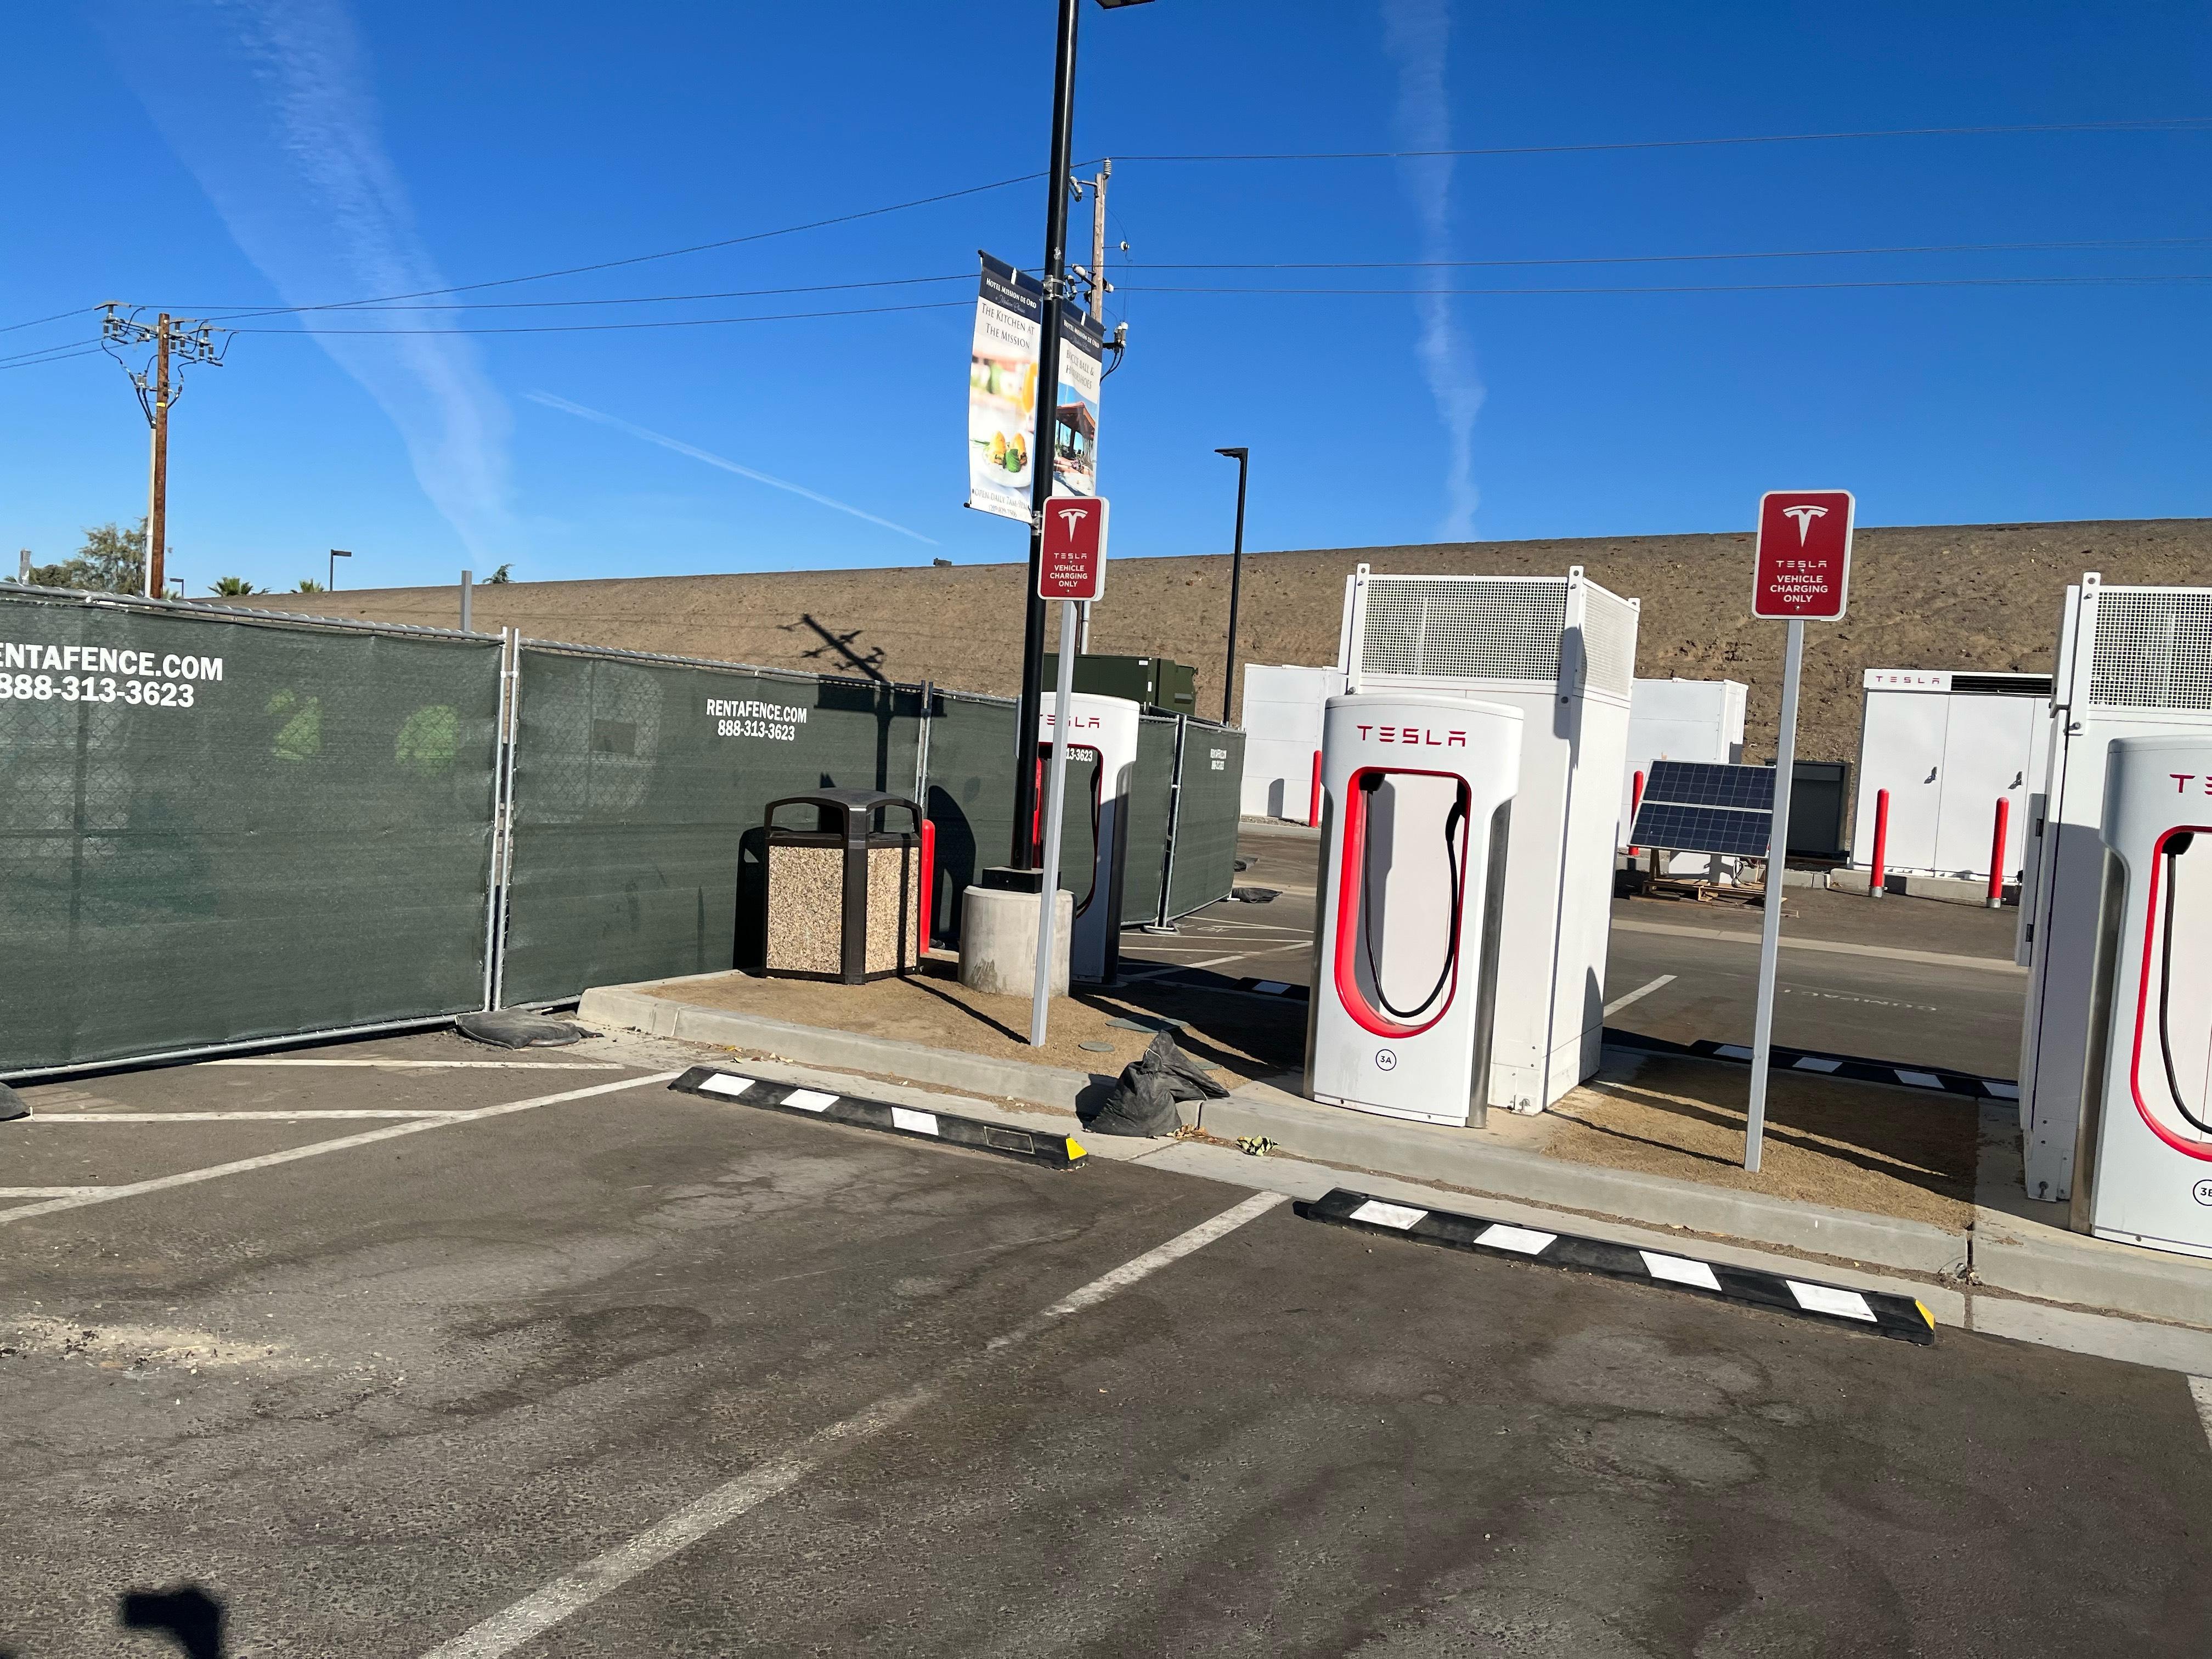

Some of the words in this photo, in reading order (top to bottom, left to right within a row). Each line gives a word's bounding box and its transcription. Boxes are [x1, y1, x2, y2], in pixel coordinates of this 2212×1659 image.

[986, 278, 1001, 291] HOTEL
[1001, 286, 1020, 300] MISSION
[1026, 298, 1037, 308] ORO
[982, 303, 994, 318] THE
[996, 310, 1025, 331] KITCHEN
[1027, 325, 1035, 335] AT
[986, 323, 999, 337] THE
[1001, 330, 1030, 349] MISSION
[975, 489, 989, 499] OPEN
[991, 493, 1006, 503] DAILY
[1770, 585, 1828, 593] CHARGING
[1777, 575, 1823, 583] VEHICLE
[0, 642, 223, 681] NTAFENCE.COM
[0, 673, 194, 708] 888-313-3623
[1876, 676, 1940, 684] TESLA
[707, 698, 808, 723] RENTAFENCE.COM
[718, 719, 795, 741] 888-313-3623
[1356, 725, 1466, 747] TESLA
[1380, 1056, 1392, 1064] 3A
